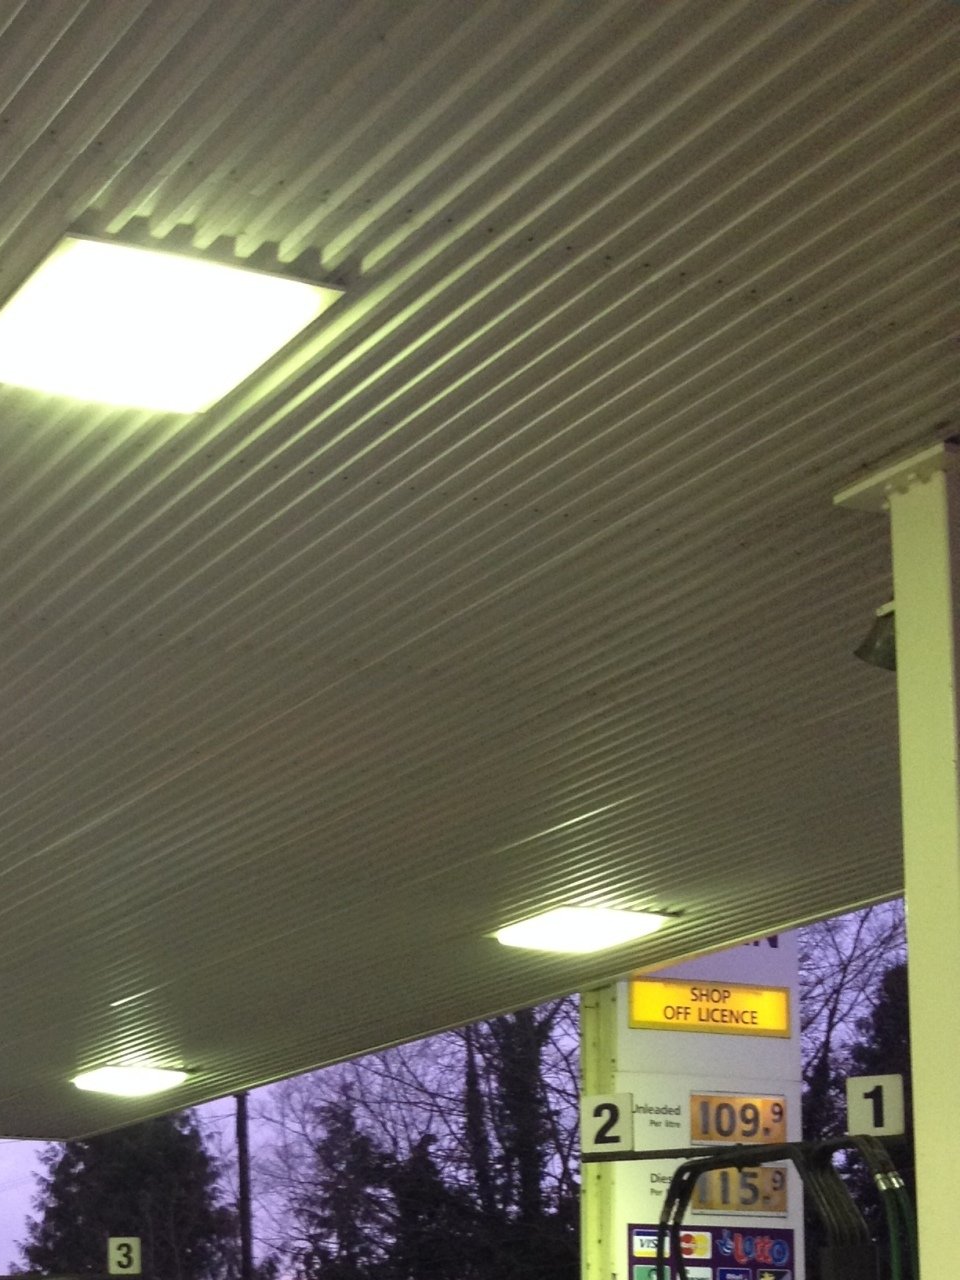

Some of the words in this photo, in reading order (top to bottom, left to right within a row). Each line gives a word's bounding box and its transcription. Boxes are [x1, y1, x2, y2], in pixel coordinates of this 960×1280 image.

[691, 987, 732, 1004] SHOP
[663, 1005, 691, 1021] OFF
[698, 1008, 758, 1025] LICENCE
[863, 1085, 884, 1128] 1
[592, 1102, 621, 1144] 2
[649, 1119, 662, 1128] Per
[650, 1172, 673, 1184] Dies
[116, 1243, 134, 1269] 3
